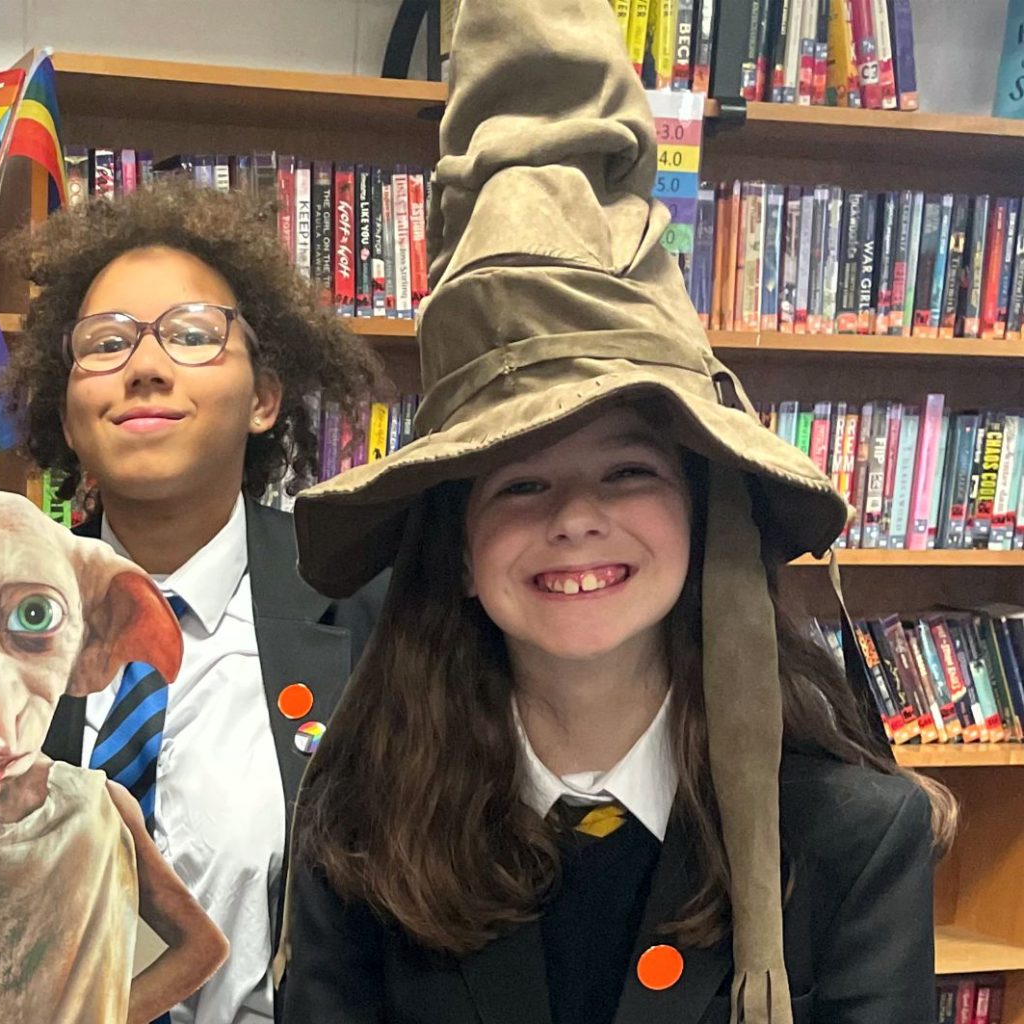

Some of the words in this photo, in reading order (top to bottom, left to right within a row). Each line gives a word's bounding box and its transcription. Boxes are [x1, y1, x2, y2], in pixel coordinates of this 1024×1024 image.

[323, 189, 331, 209] THE
[298, 200, 311, 239] KEEP
[323, 211, 331, 234] GIRL
[360, 202, 370, 224] LIKE
[323, 236, 331, 252] ON
[360, 224, 370, 245] YOU
[323, 254, 331, 272] THE
[861, 240, 875, 273] WAR
[982, 431, 1003, 470] CHAOS
